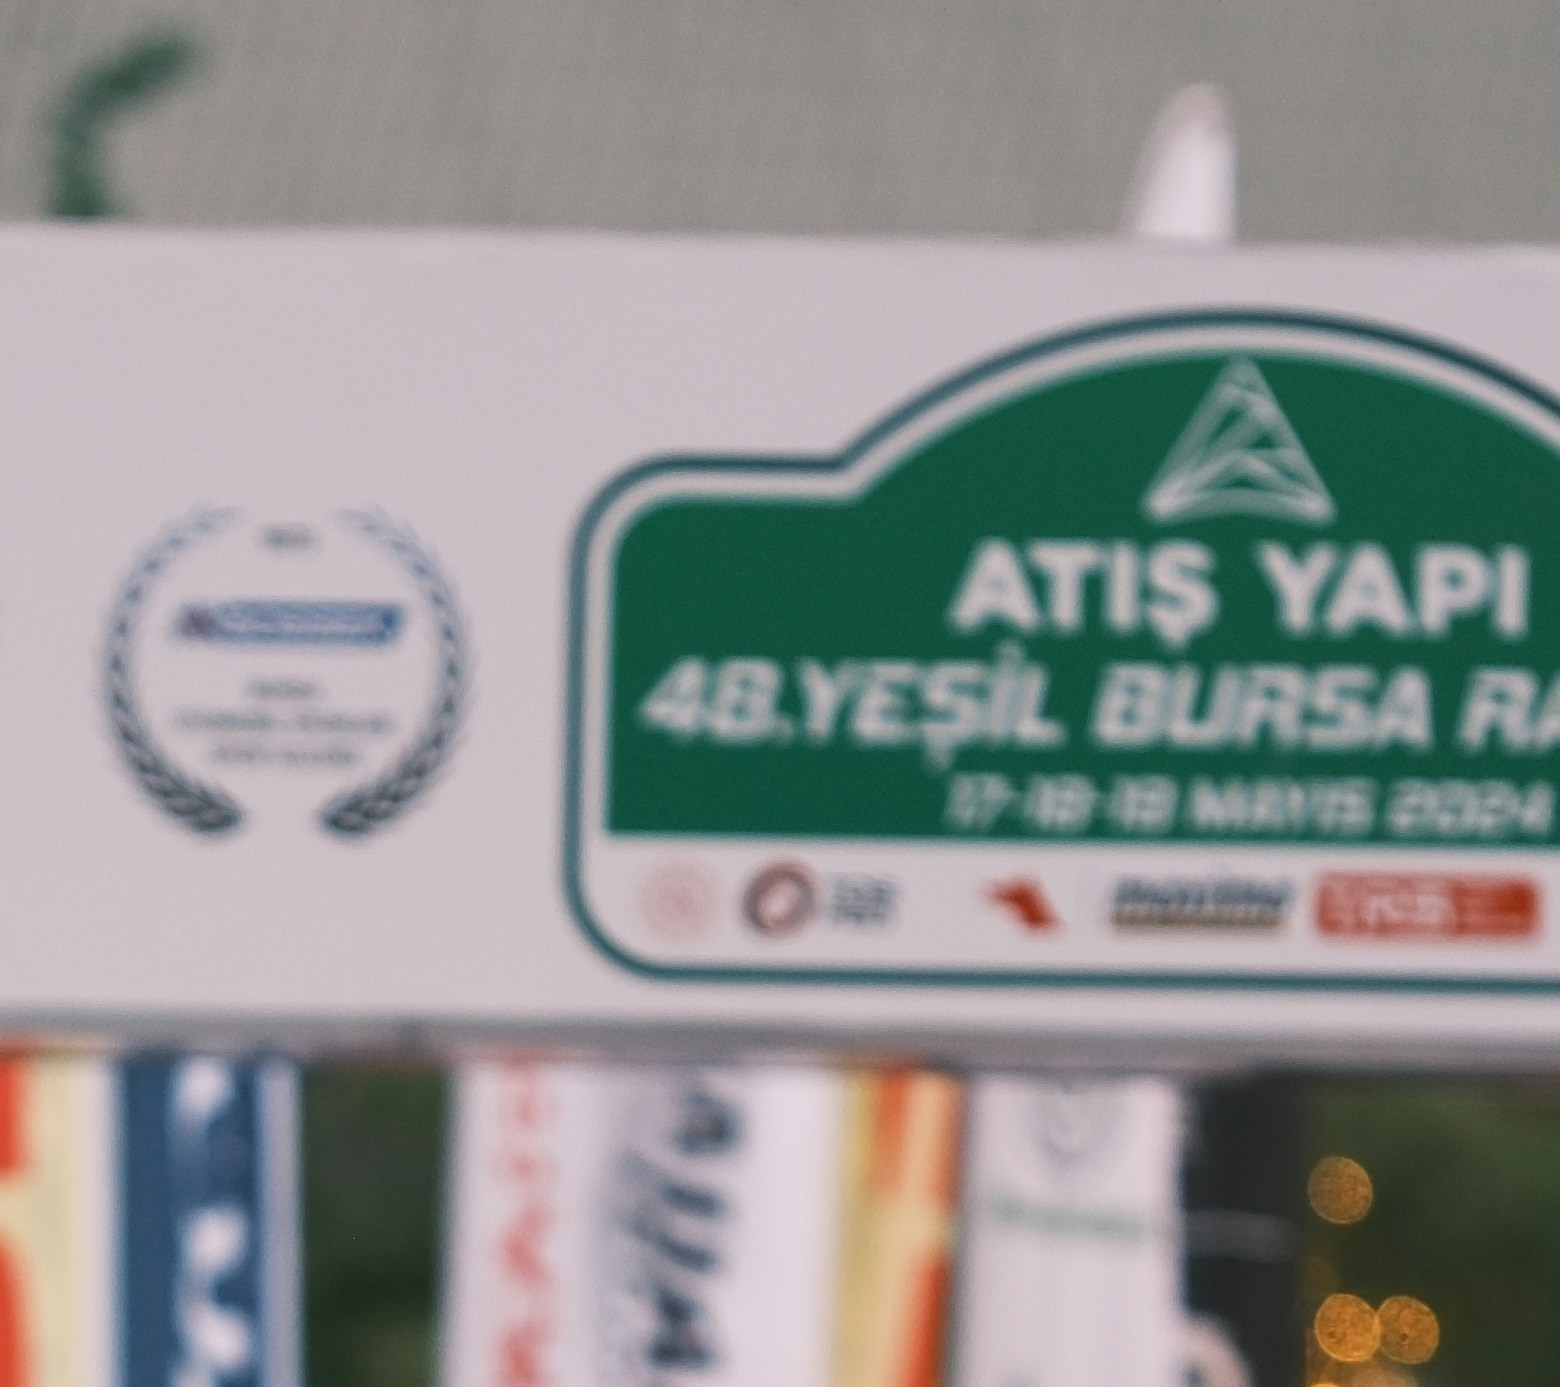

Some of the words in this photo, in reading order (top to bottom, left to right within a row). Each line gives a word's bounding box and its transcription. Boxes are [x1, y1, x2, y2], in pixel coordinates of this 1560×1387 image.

[950, 543, 1218, 650] ATIŞ
[1256, 545, 1530, 638] YAPI
[640, 640, 1066, 770] 48.YEŞİL
[1092, 660, 1432, 750] BURSA
[1188, 775, 1377, 834] MAYIS
[1383, 777, 1553, 836] 2024
